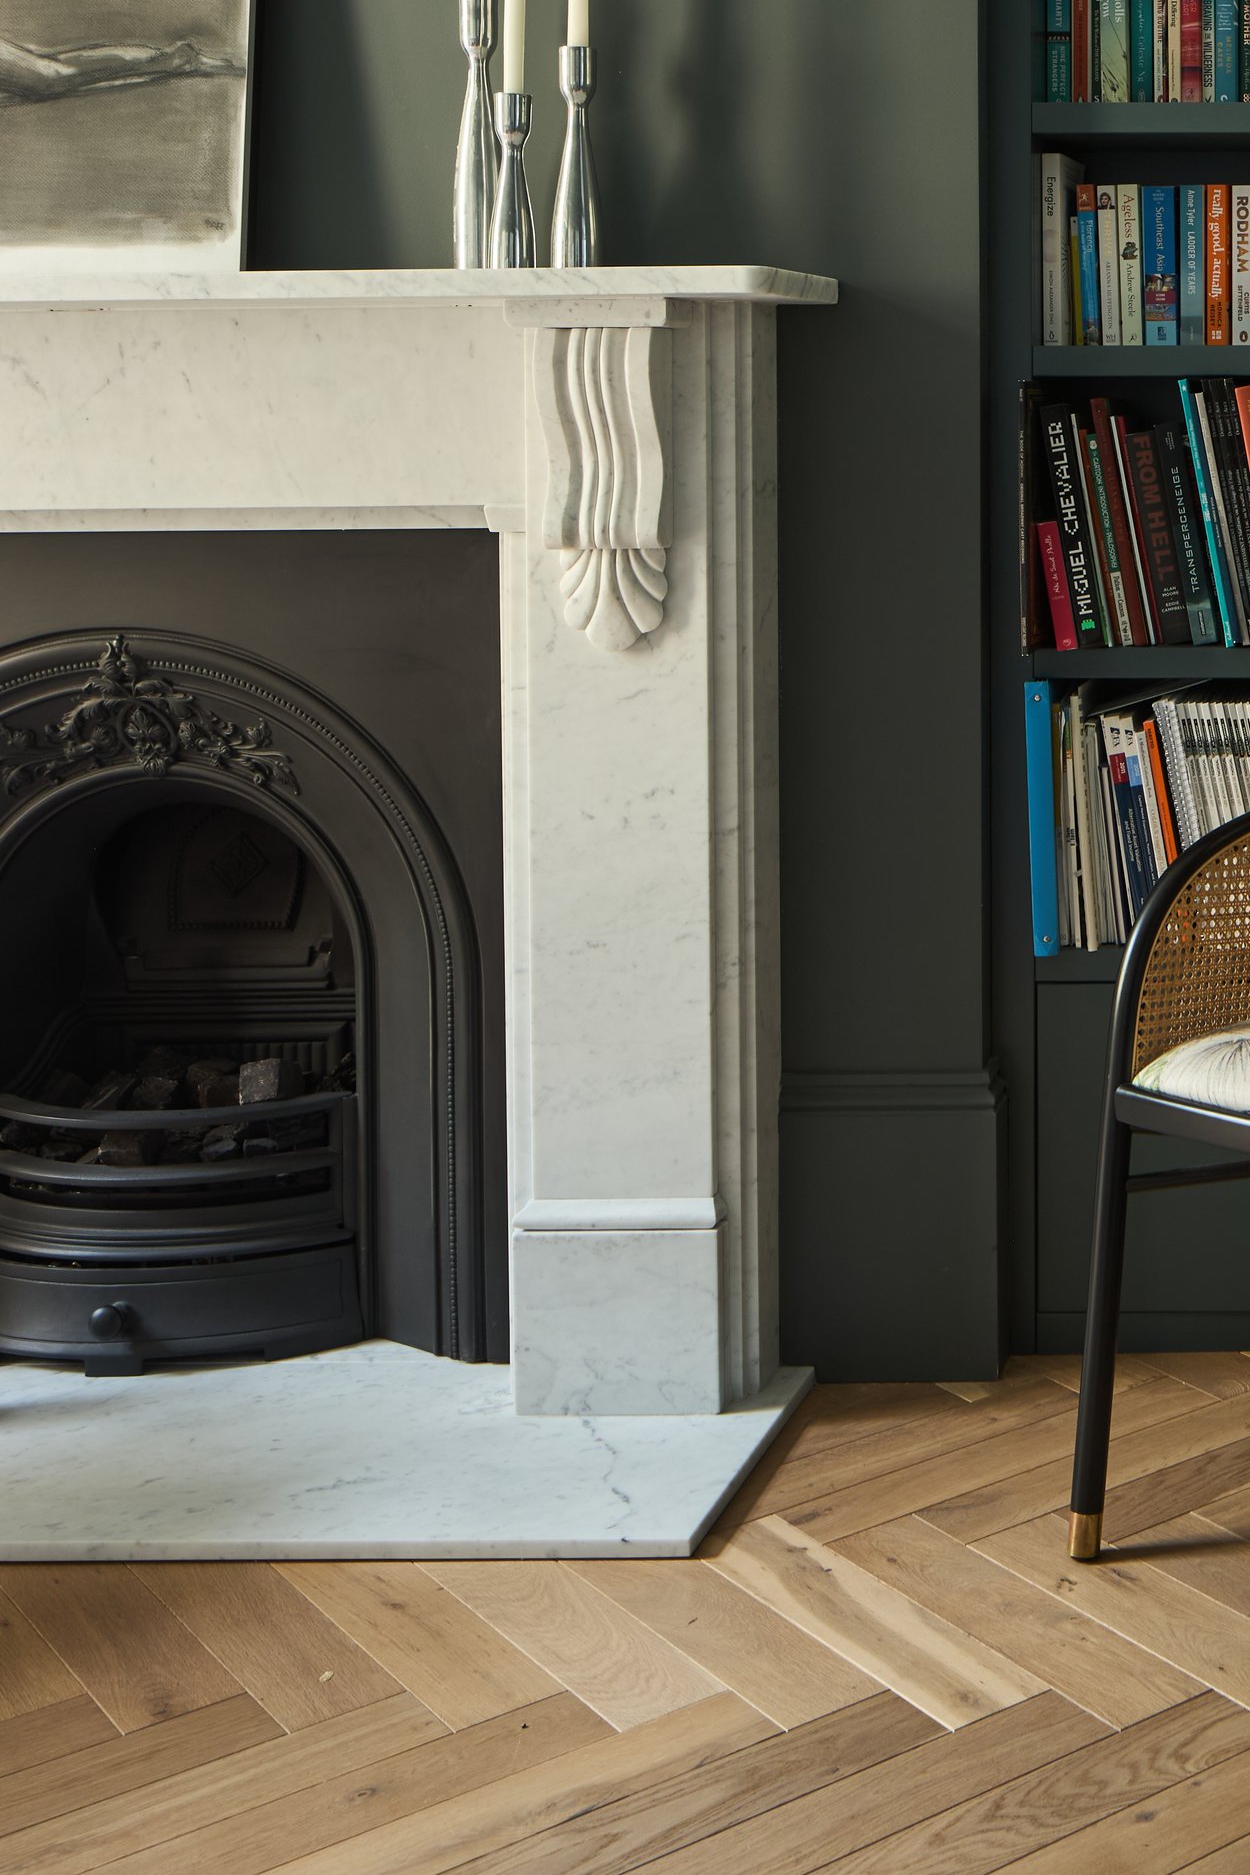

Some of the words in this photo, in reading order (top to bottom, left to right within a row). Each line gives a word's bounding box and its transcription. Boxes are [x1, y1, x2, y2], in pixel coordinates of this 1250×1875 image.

[1045, 176, 1056, 216] Energize
[1187, 189, 1195, 207] Anne
[1121, 194, 1136, 239] Ageless
[1155, 207, 1164, 250] Southeast
[1186, 209, 1195, 225] Tyler
[1236, 196, 1249, 272] RODHAM
[1126, 263, 1135, 292] Andrew
[1156, 254, 1165, 272] Asia
[1188, 260, 1196, 270] OF
[1188, 272, 1196, 294] YEARS
[1127, 294, 1136, 317] Steele
[1048, 421, 1079, 536] CHEVALIER
[1131, 434, 1161, 506] FROM
[1148, 511, 1171, 581] HELL
[1171, 466, 1200, 593] TRANSPERCENEIGE
[1070, 540, 1094, 616] MIGUEL
